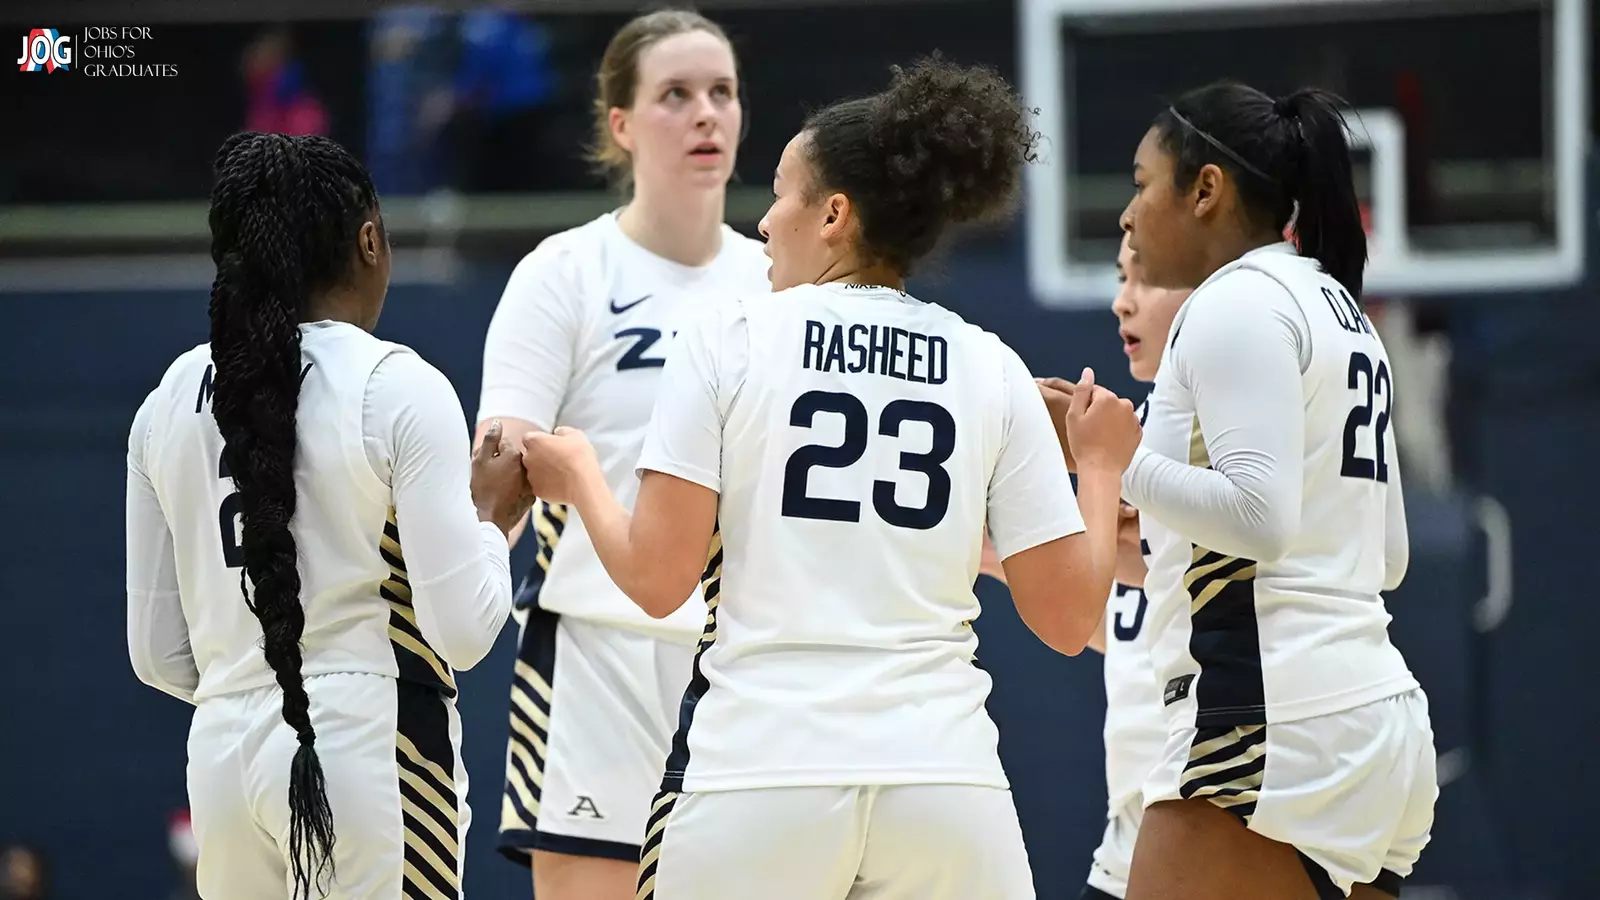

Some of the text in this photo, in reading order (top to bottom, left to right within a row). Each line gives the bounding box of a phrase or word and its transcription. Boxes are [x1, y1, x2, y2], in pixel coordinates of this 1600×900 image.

[803, 319, 948, 385] RASHEED
[1340, 351, 1391, 484] 22
[781, 390, 956, 530] 23
